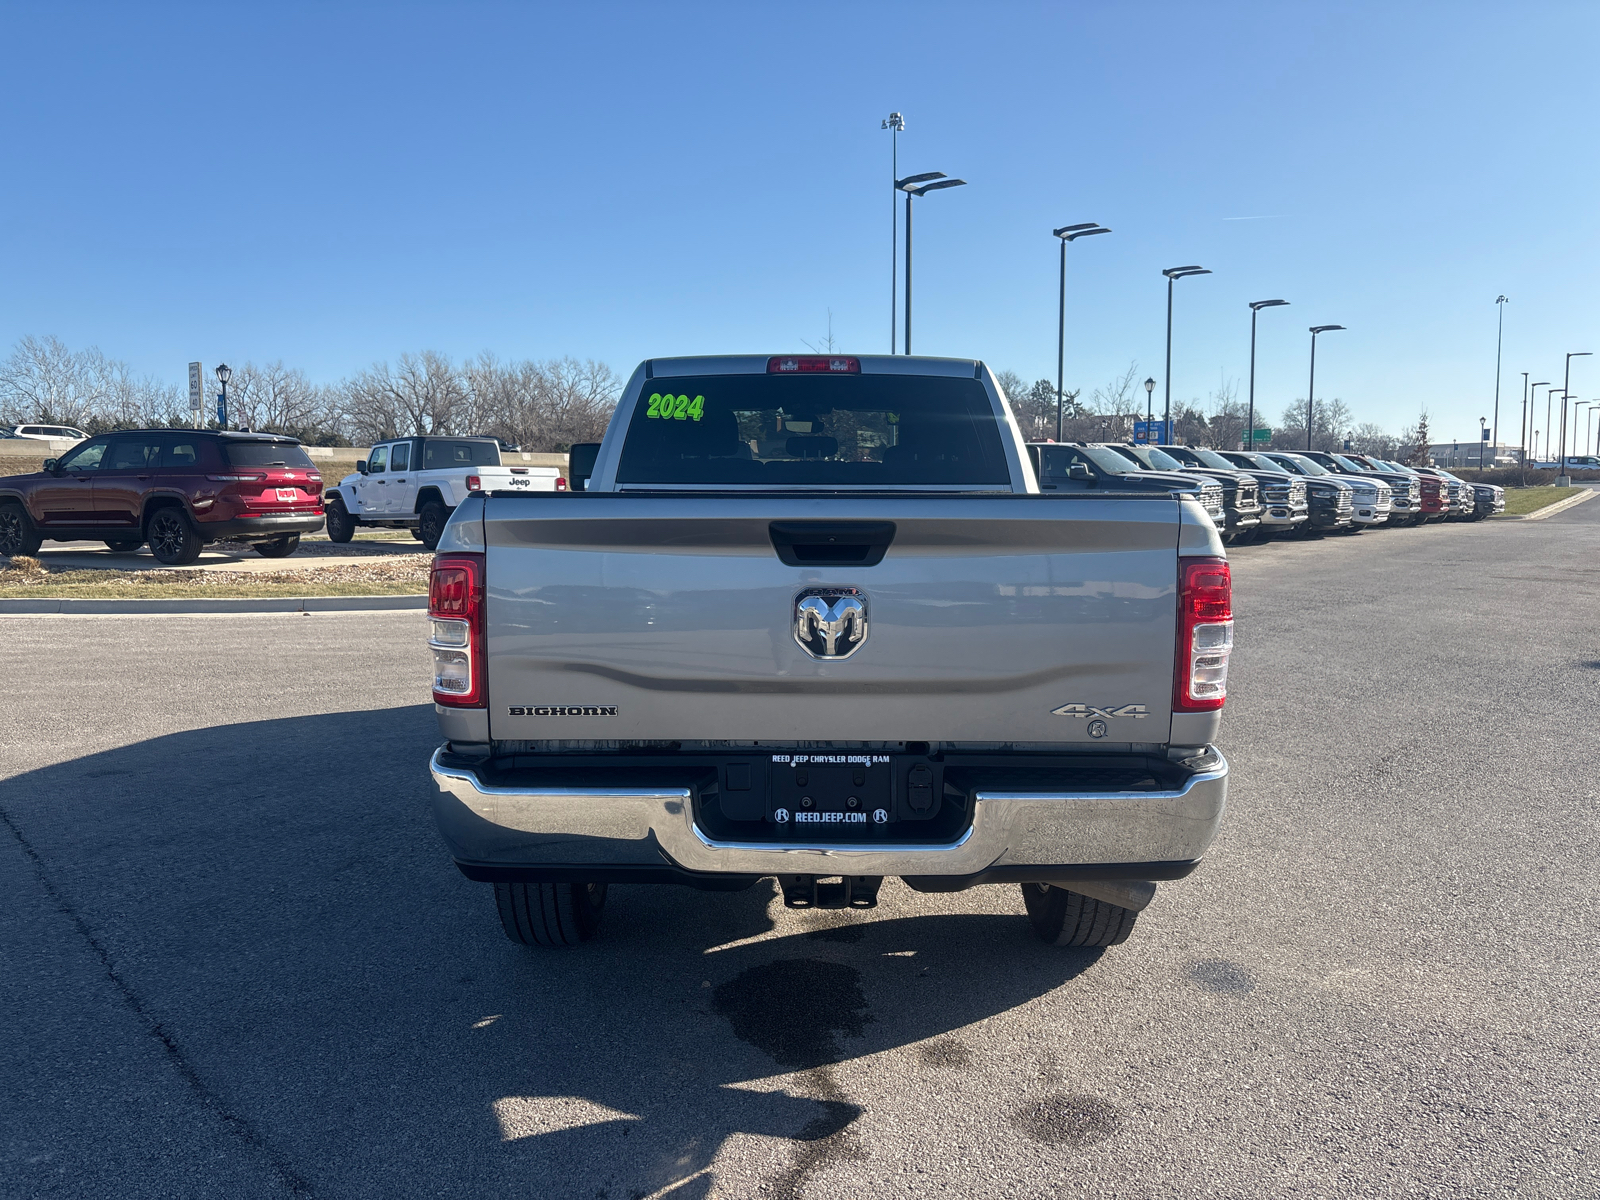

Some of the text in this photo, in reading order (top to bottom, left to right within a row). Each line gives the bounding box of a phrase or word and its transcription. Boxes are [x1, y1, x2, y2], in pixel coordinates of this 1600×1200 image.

[190, 380, 198, 389] 60
[646, 392, 705, 422] 2024
[509, 477, 531, 487] Jeep
[808, 588, 856, 596] RAM
[508, 705, 618, 716] BIGHORN
[772, 754, 890, 763] REED JEEP CHRYSLER DODGE RAM
[795, 812, 867, 823] REEDJEEP.COM
